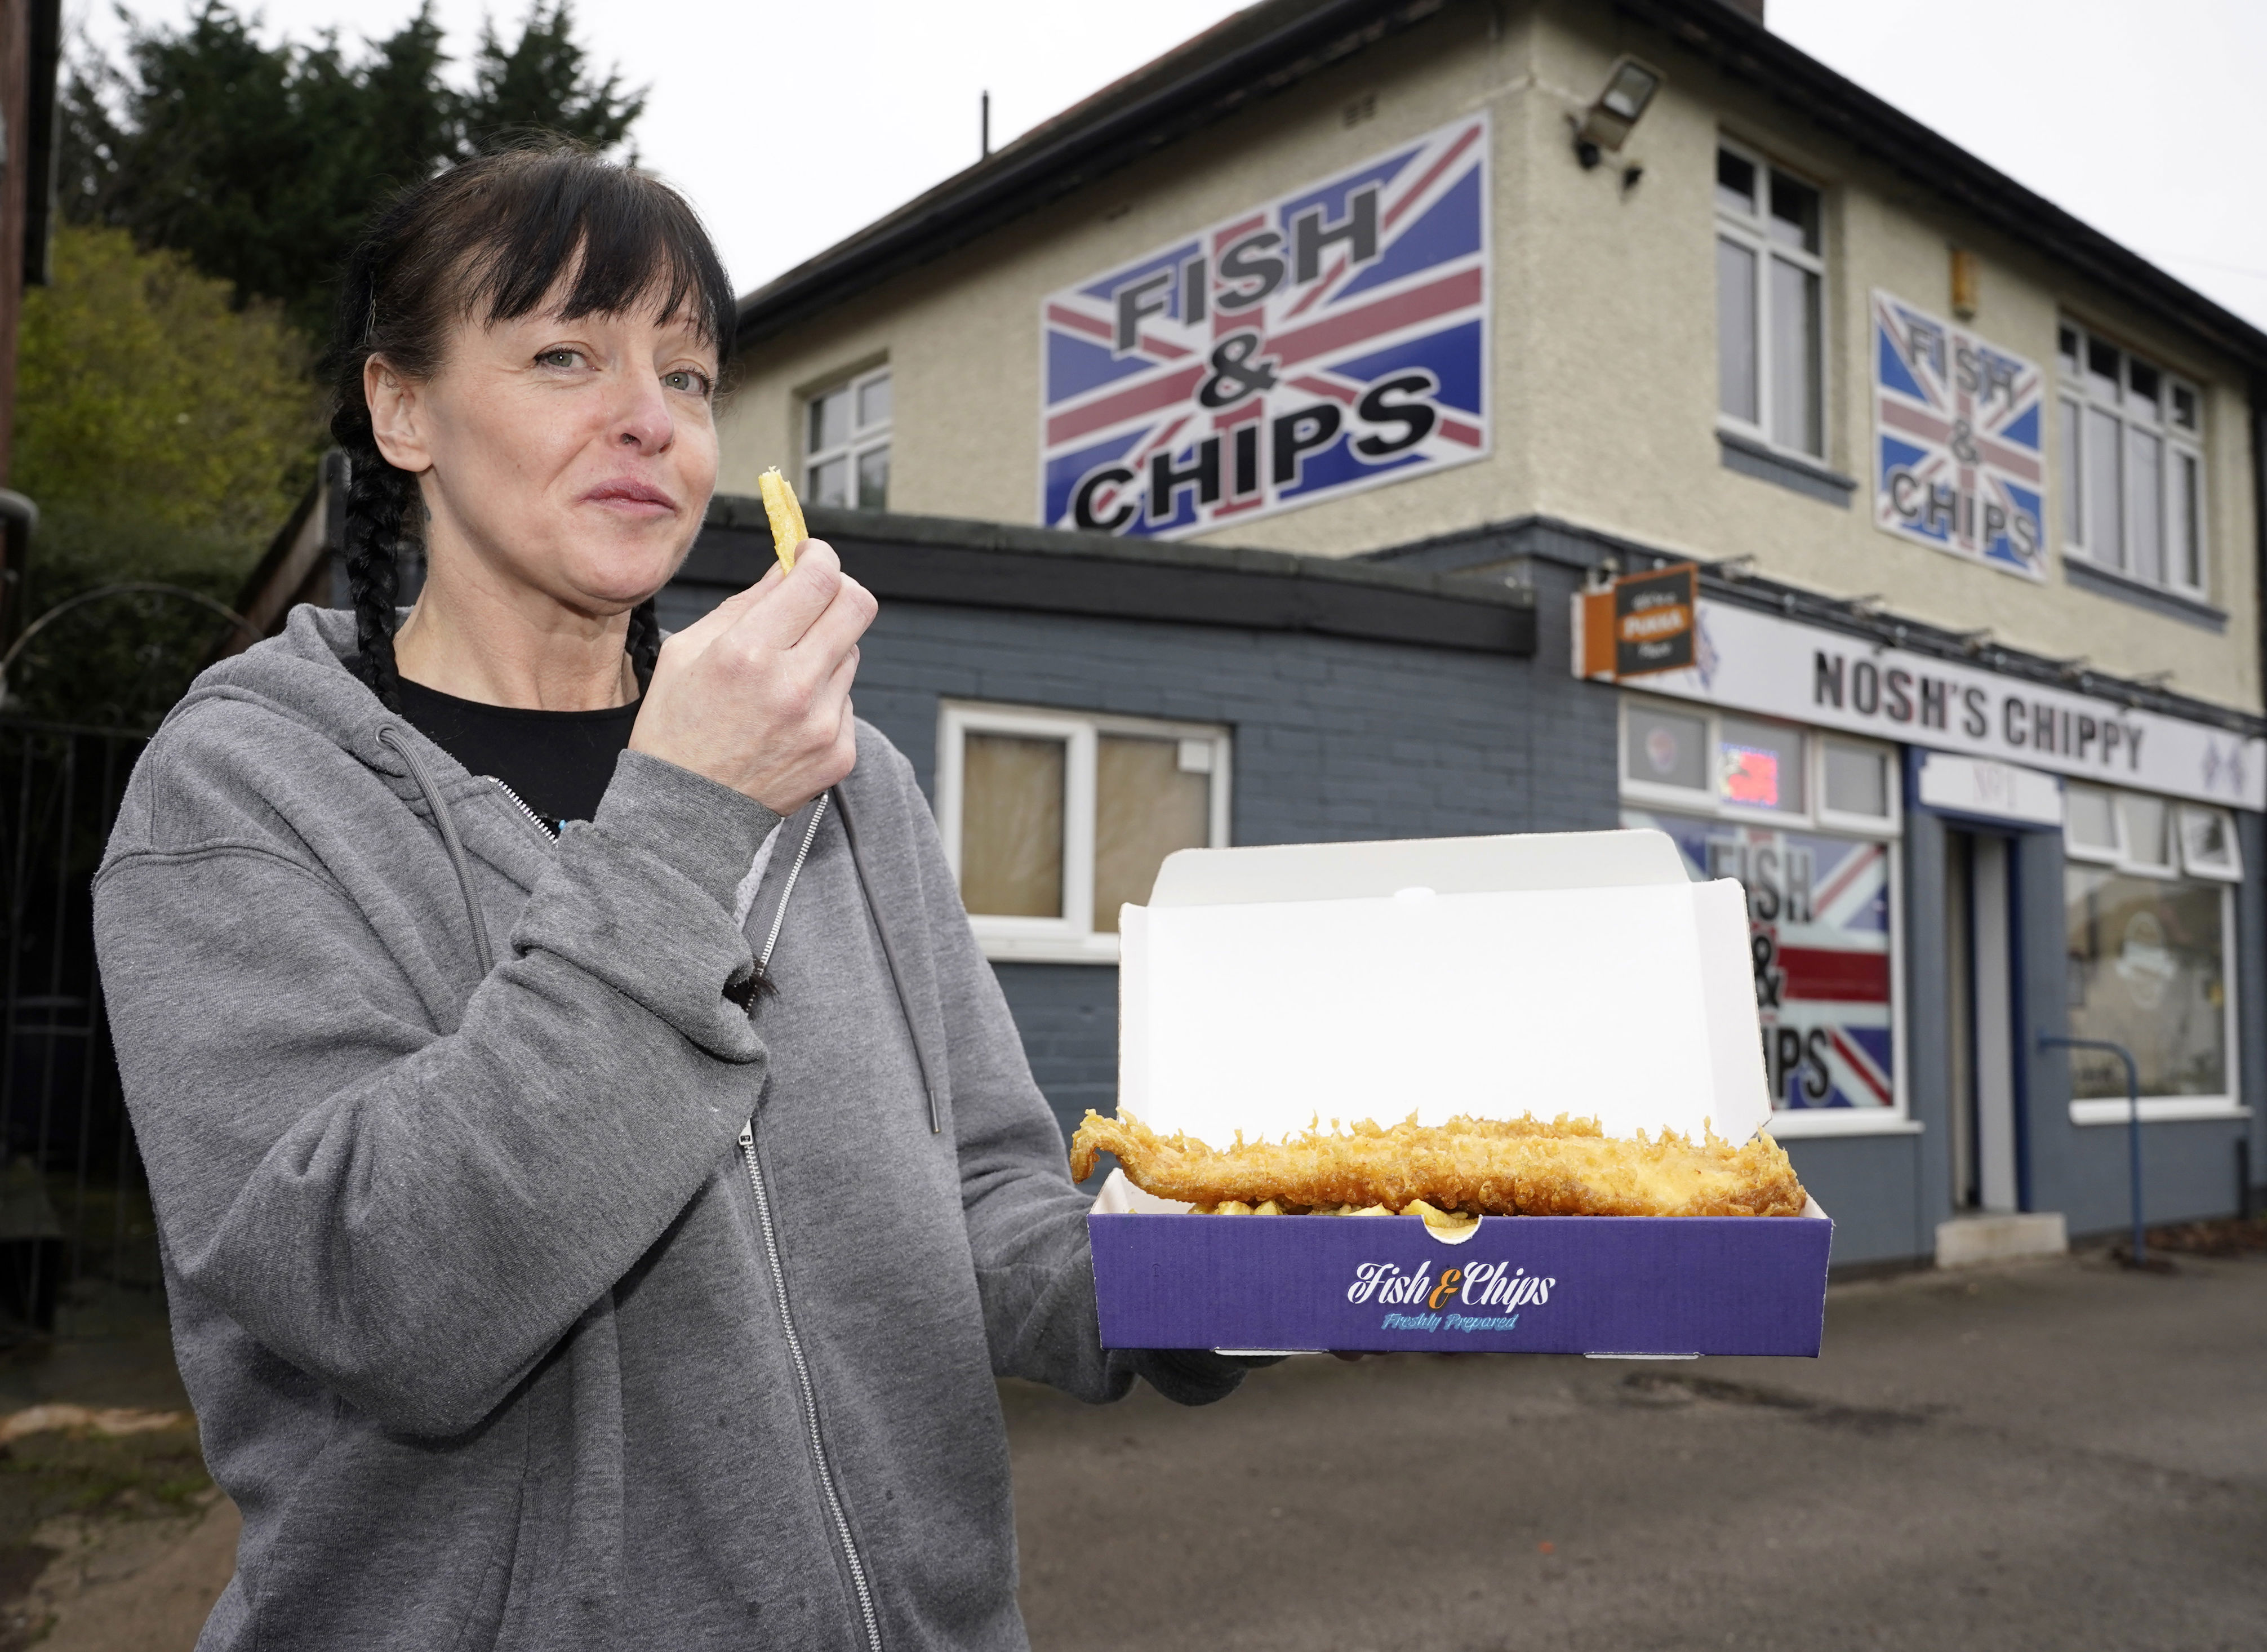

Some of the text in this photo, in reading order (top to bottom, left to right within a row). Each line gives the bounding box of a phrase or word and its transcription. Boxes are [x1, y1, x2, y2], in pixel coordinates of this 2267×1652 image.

[1116, 187, 1378, 353] FISH
[1199, 334, 1281, 409] &
[1908, 325, 2017, 411] FISH
[1074, 376, 1435, 532] CHIPS
[1952, 419, 1979, 465] &
[1892, 472, 2035, 557] CHIPS
[1815, 651, 2144, 771] NOSH'S CHIPPY
[1753, 936, 1780, 1008] &
[1347, 1260, 1556, 1313] Fish & Chips
[1381, 1312, 1520, 1333] Freshly Prepared
